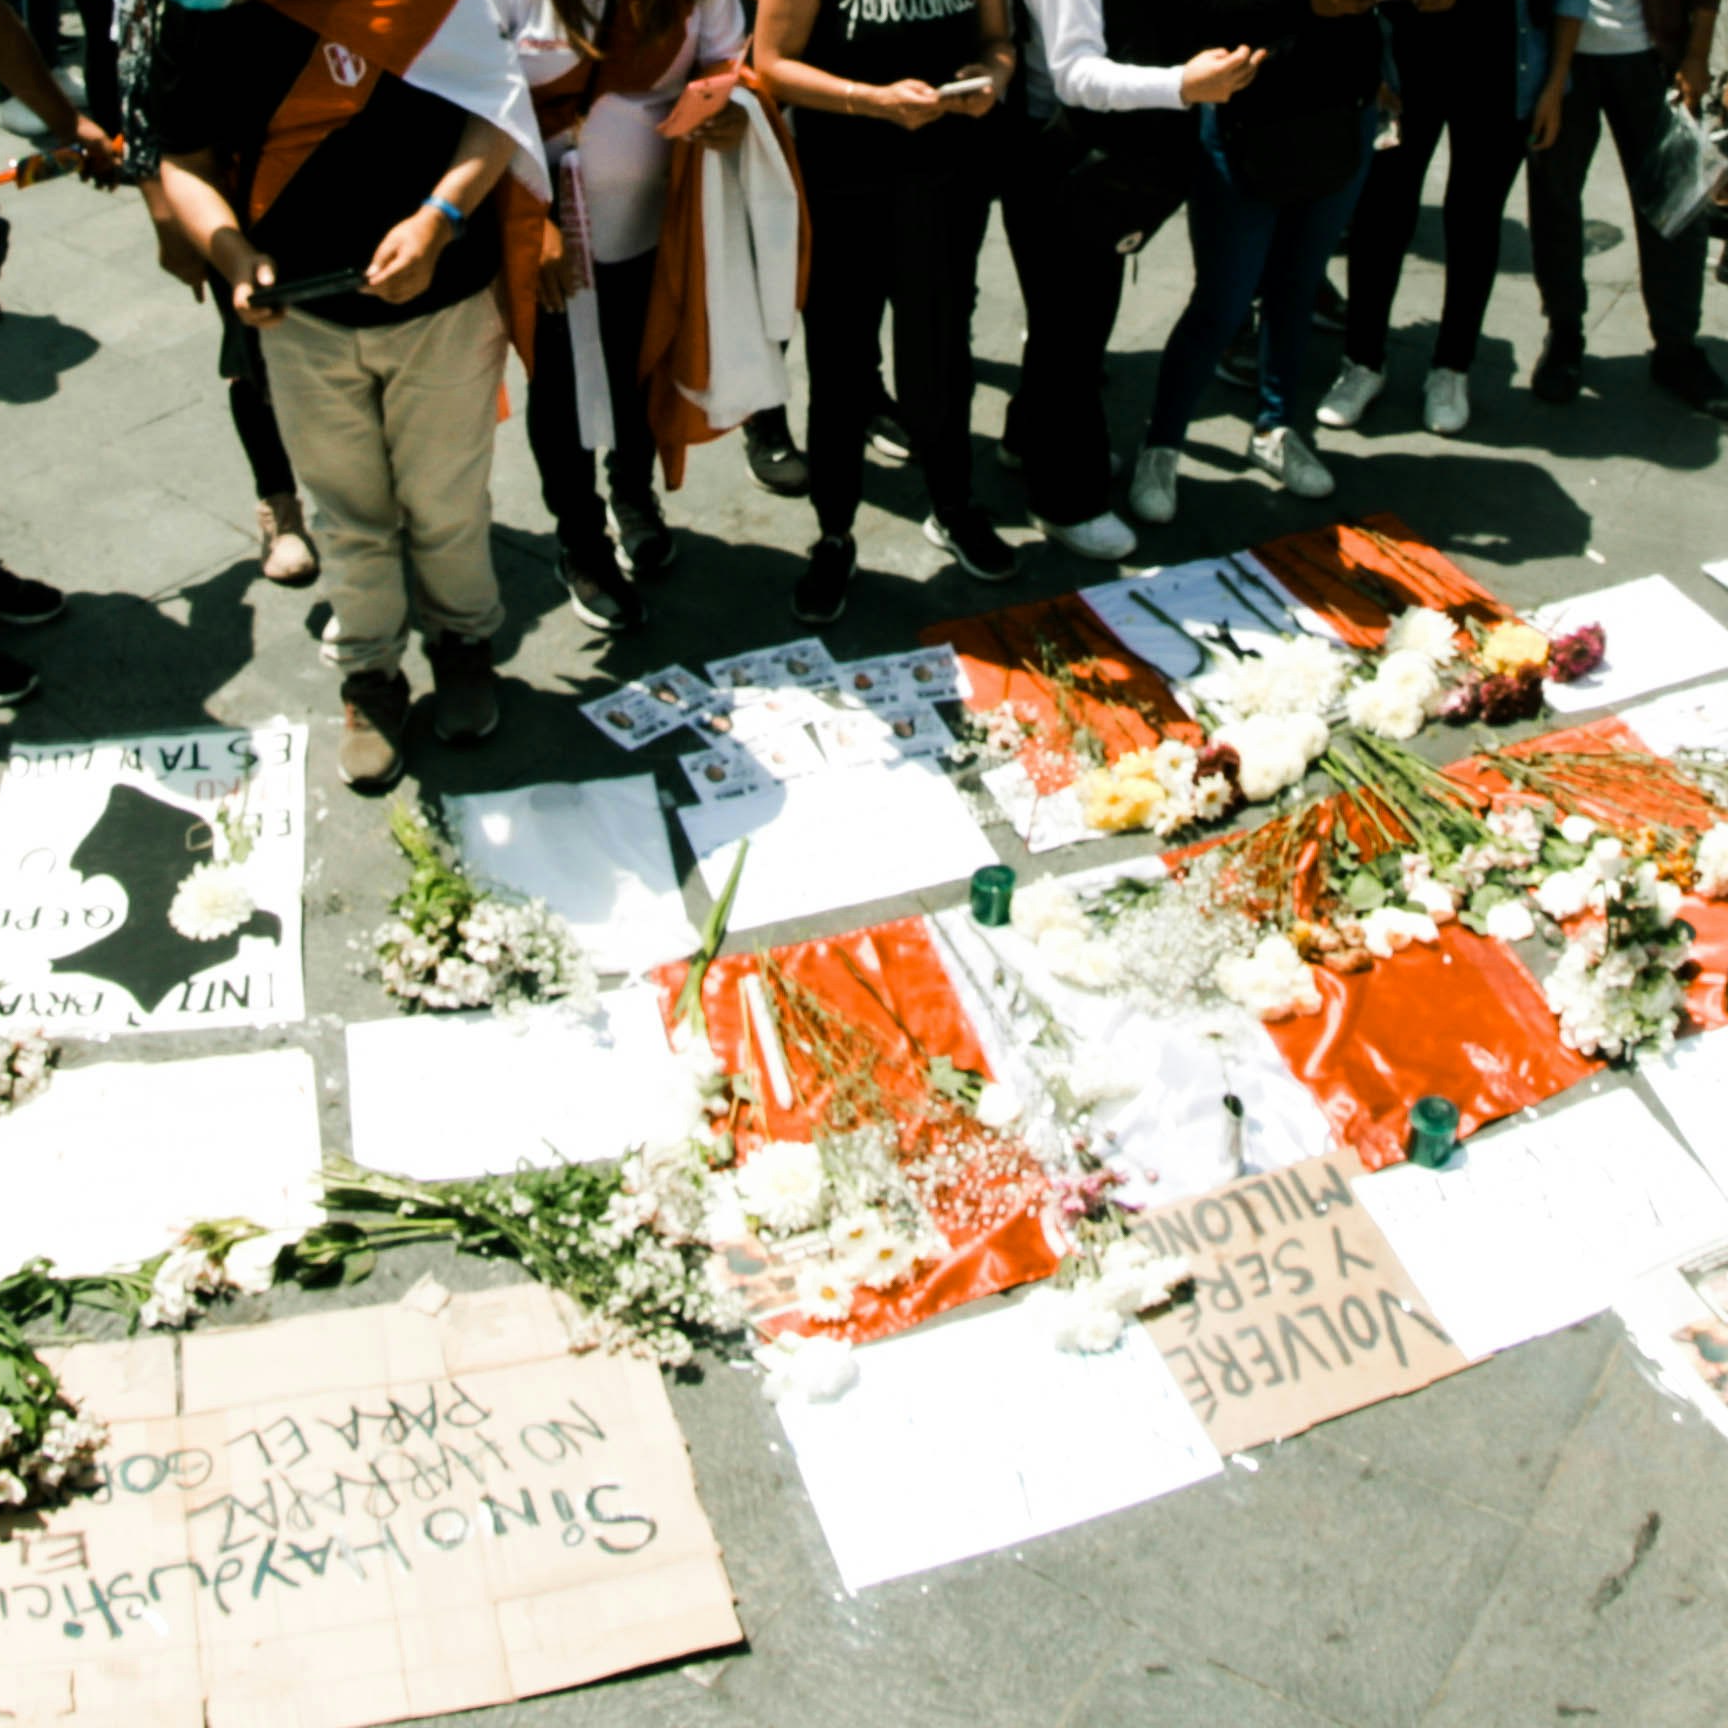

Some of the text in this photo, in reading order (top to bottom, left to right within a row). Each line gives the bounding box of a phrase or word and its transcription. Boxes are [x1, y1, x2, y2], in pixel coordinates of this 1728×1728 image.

[1331, 1225, 1376, 1279] Y
[1162, 1288, 1453, 1425] VOLVERÉ
[224, 1414, 311, 1469] EL
[316, 1381, 492, 1452] PARA
